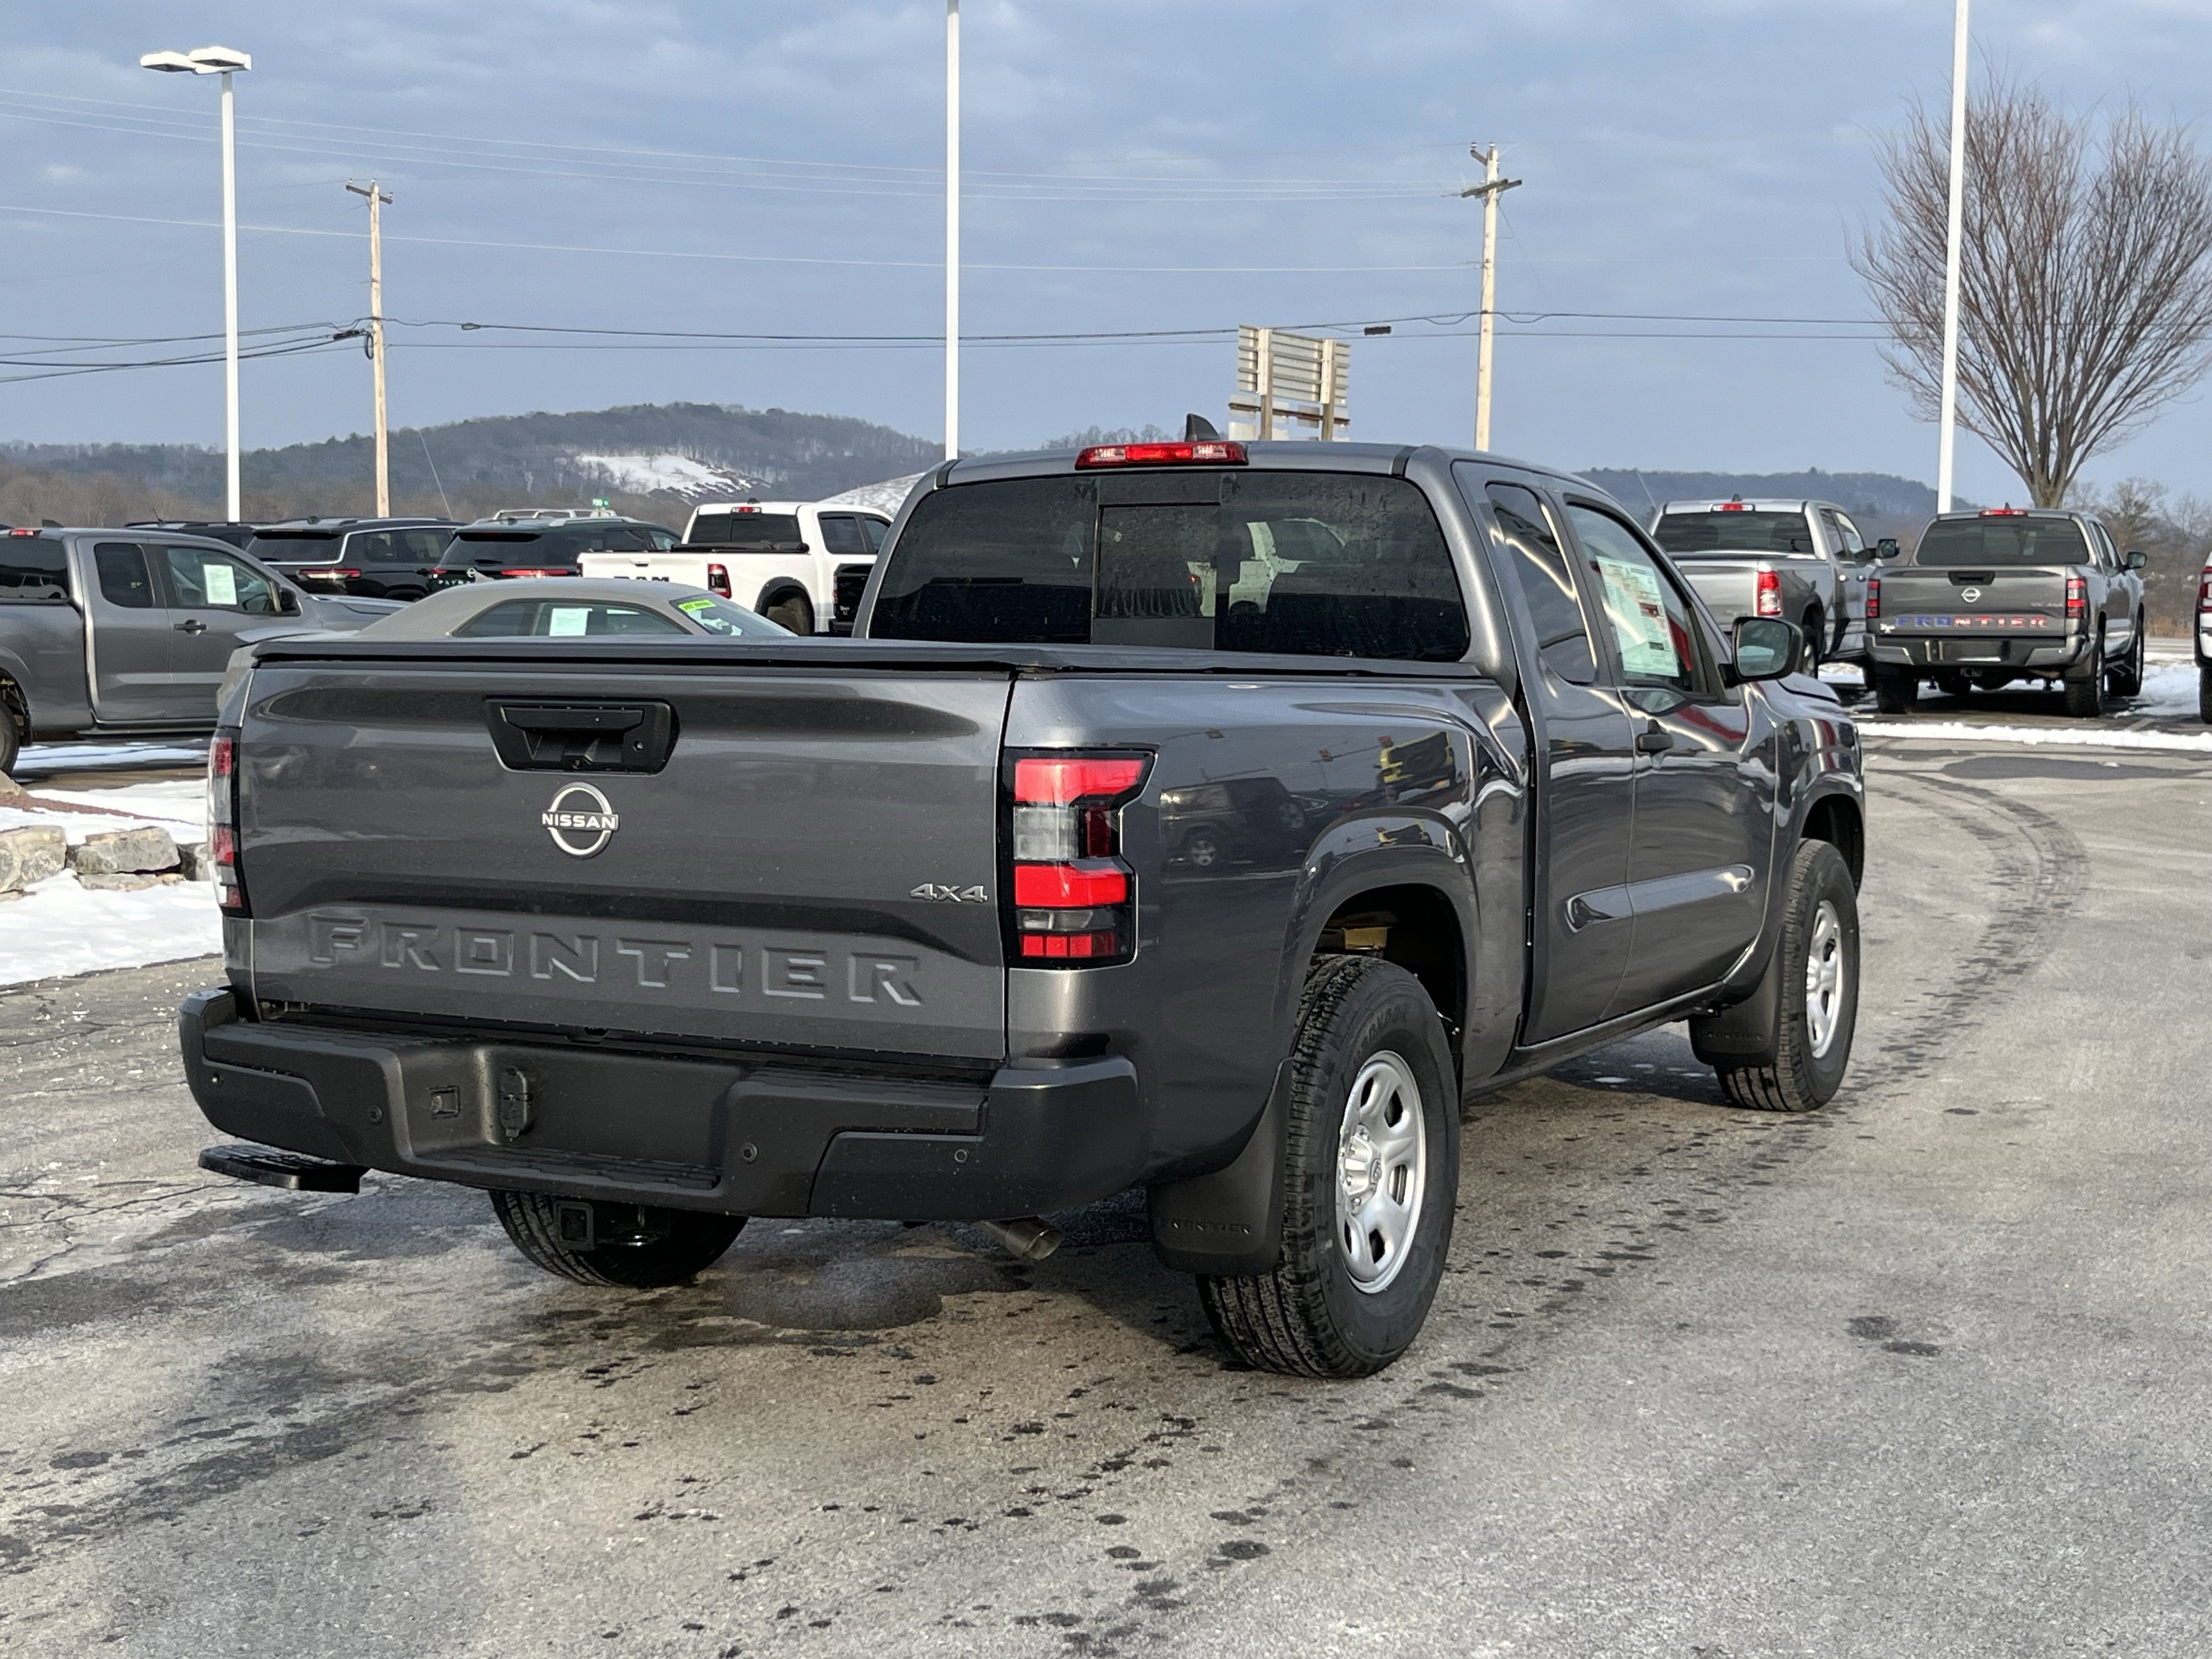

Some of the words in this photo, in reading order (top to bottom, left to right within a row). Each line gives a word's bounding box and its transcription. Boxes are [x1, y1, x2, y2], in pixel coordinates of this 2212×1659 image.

[1895, 616, 2046, 628] FRONTIER
[541, 812, 616, 829] NISSAN
[309, 915, 923, 1006] FRONTIER
